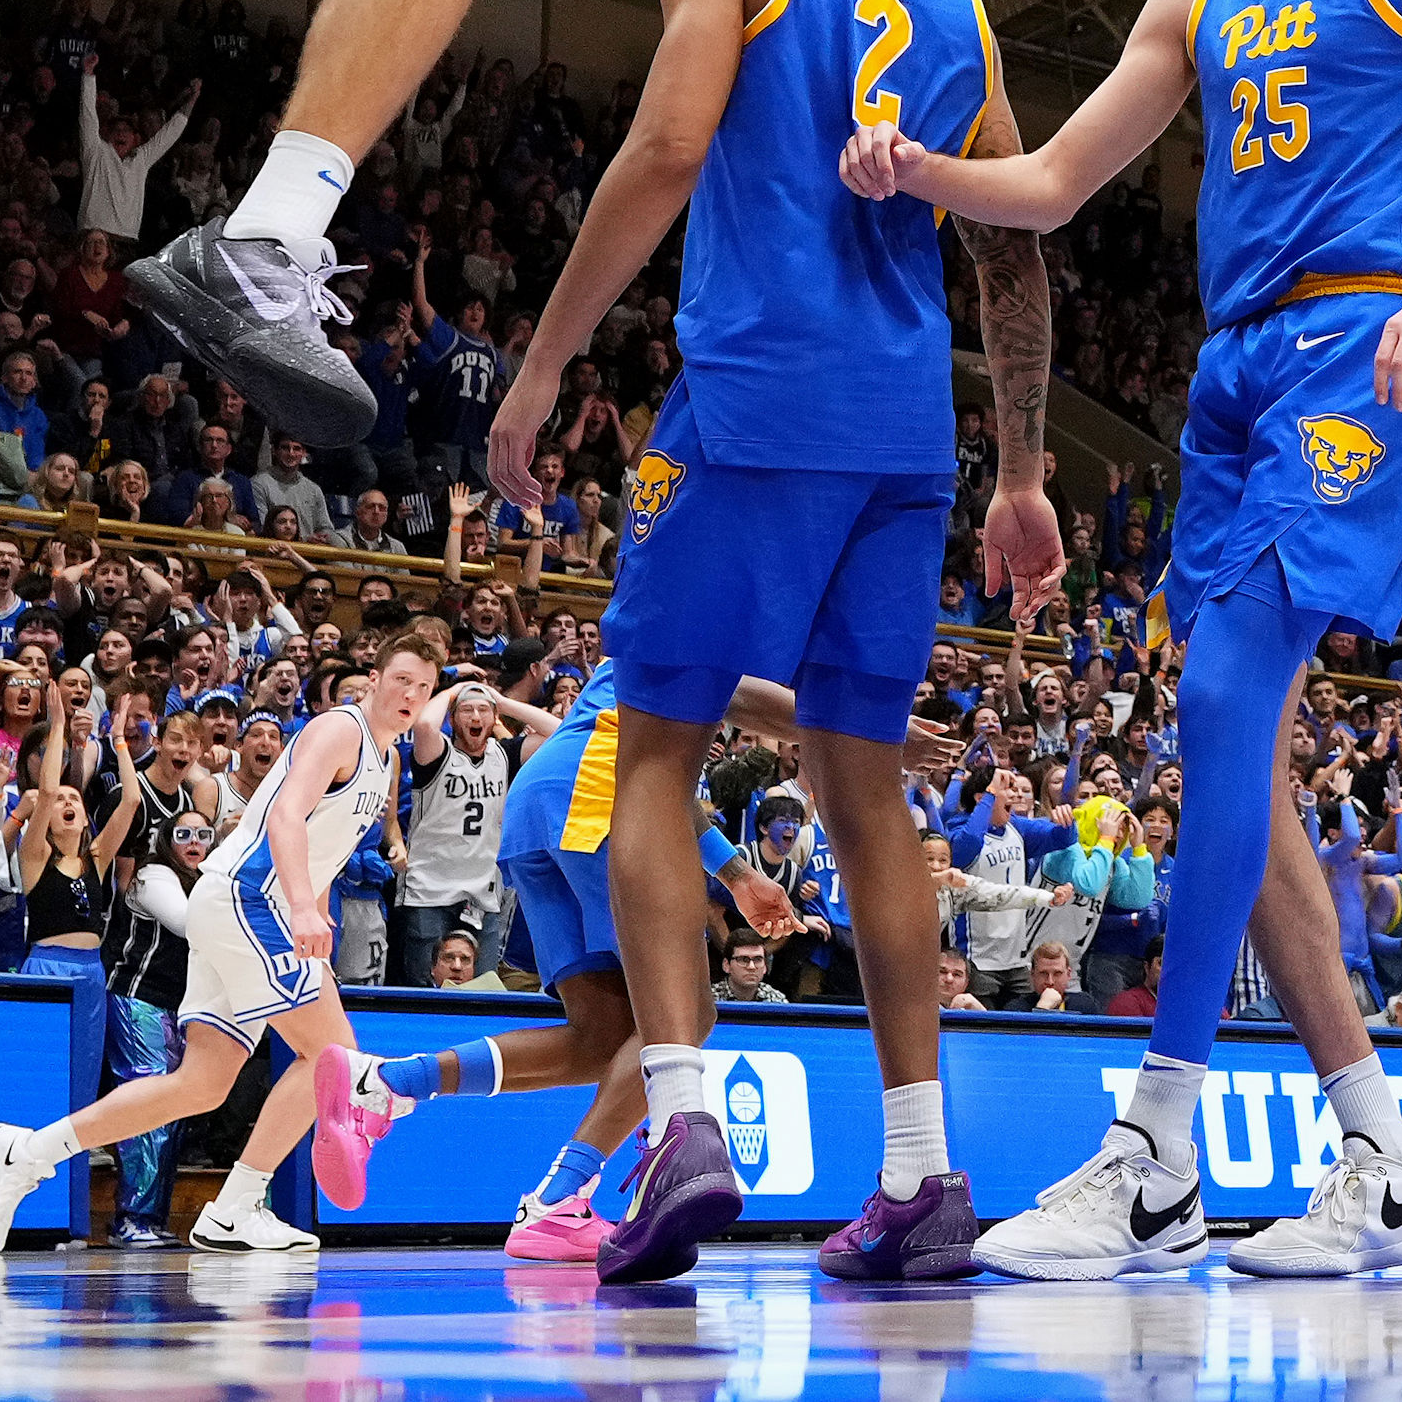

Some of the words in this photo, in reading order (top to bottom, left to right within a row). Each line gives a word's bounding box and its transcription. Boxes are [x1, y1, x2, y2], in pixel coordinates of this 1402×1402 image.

[1220, 0, 1317, 68] Pitt
[1231, 66, 1310, 175] 25
[460, 366, 486, 403] 11
[522, 519, 563, 538] DKE
[445, 773, 504, 799] Duke
[352, 791, 385, 817] DUK
[463, 801, 483, 836] 2
[986, 846, 1021, 868] DUKE
